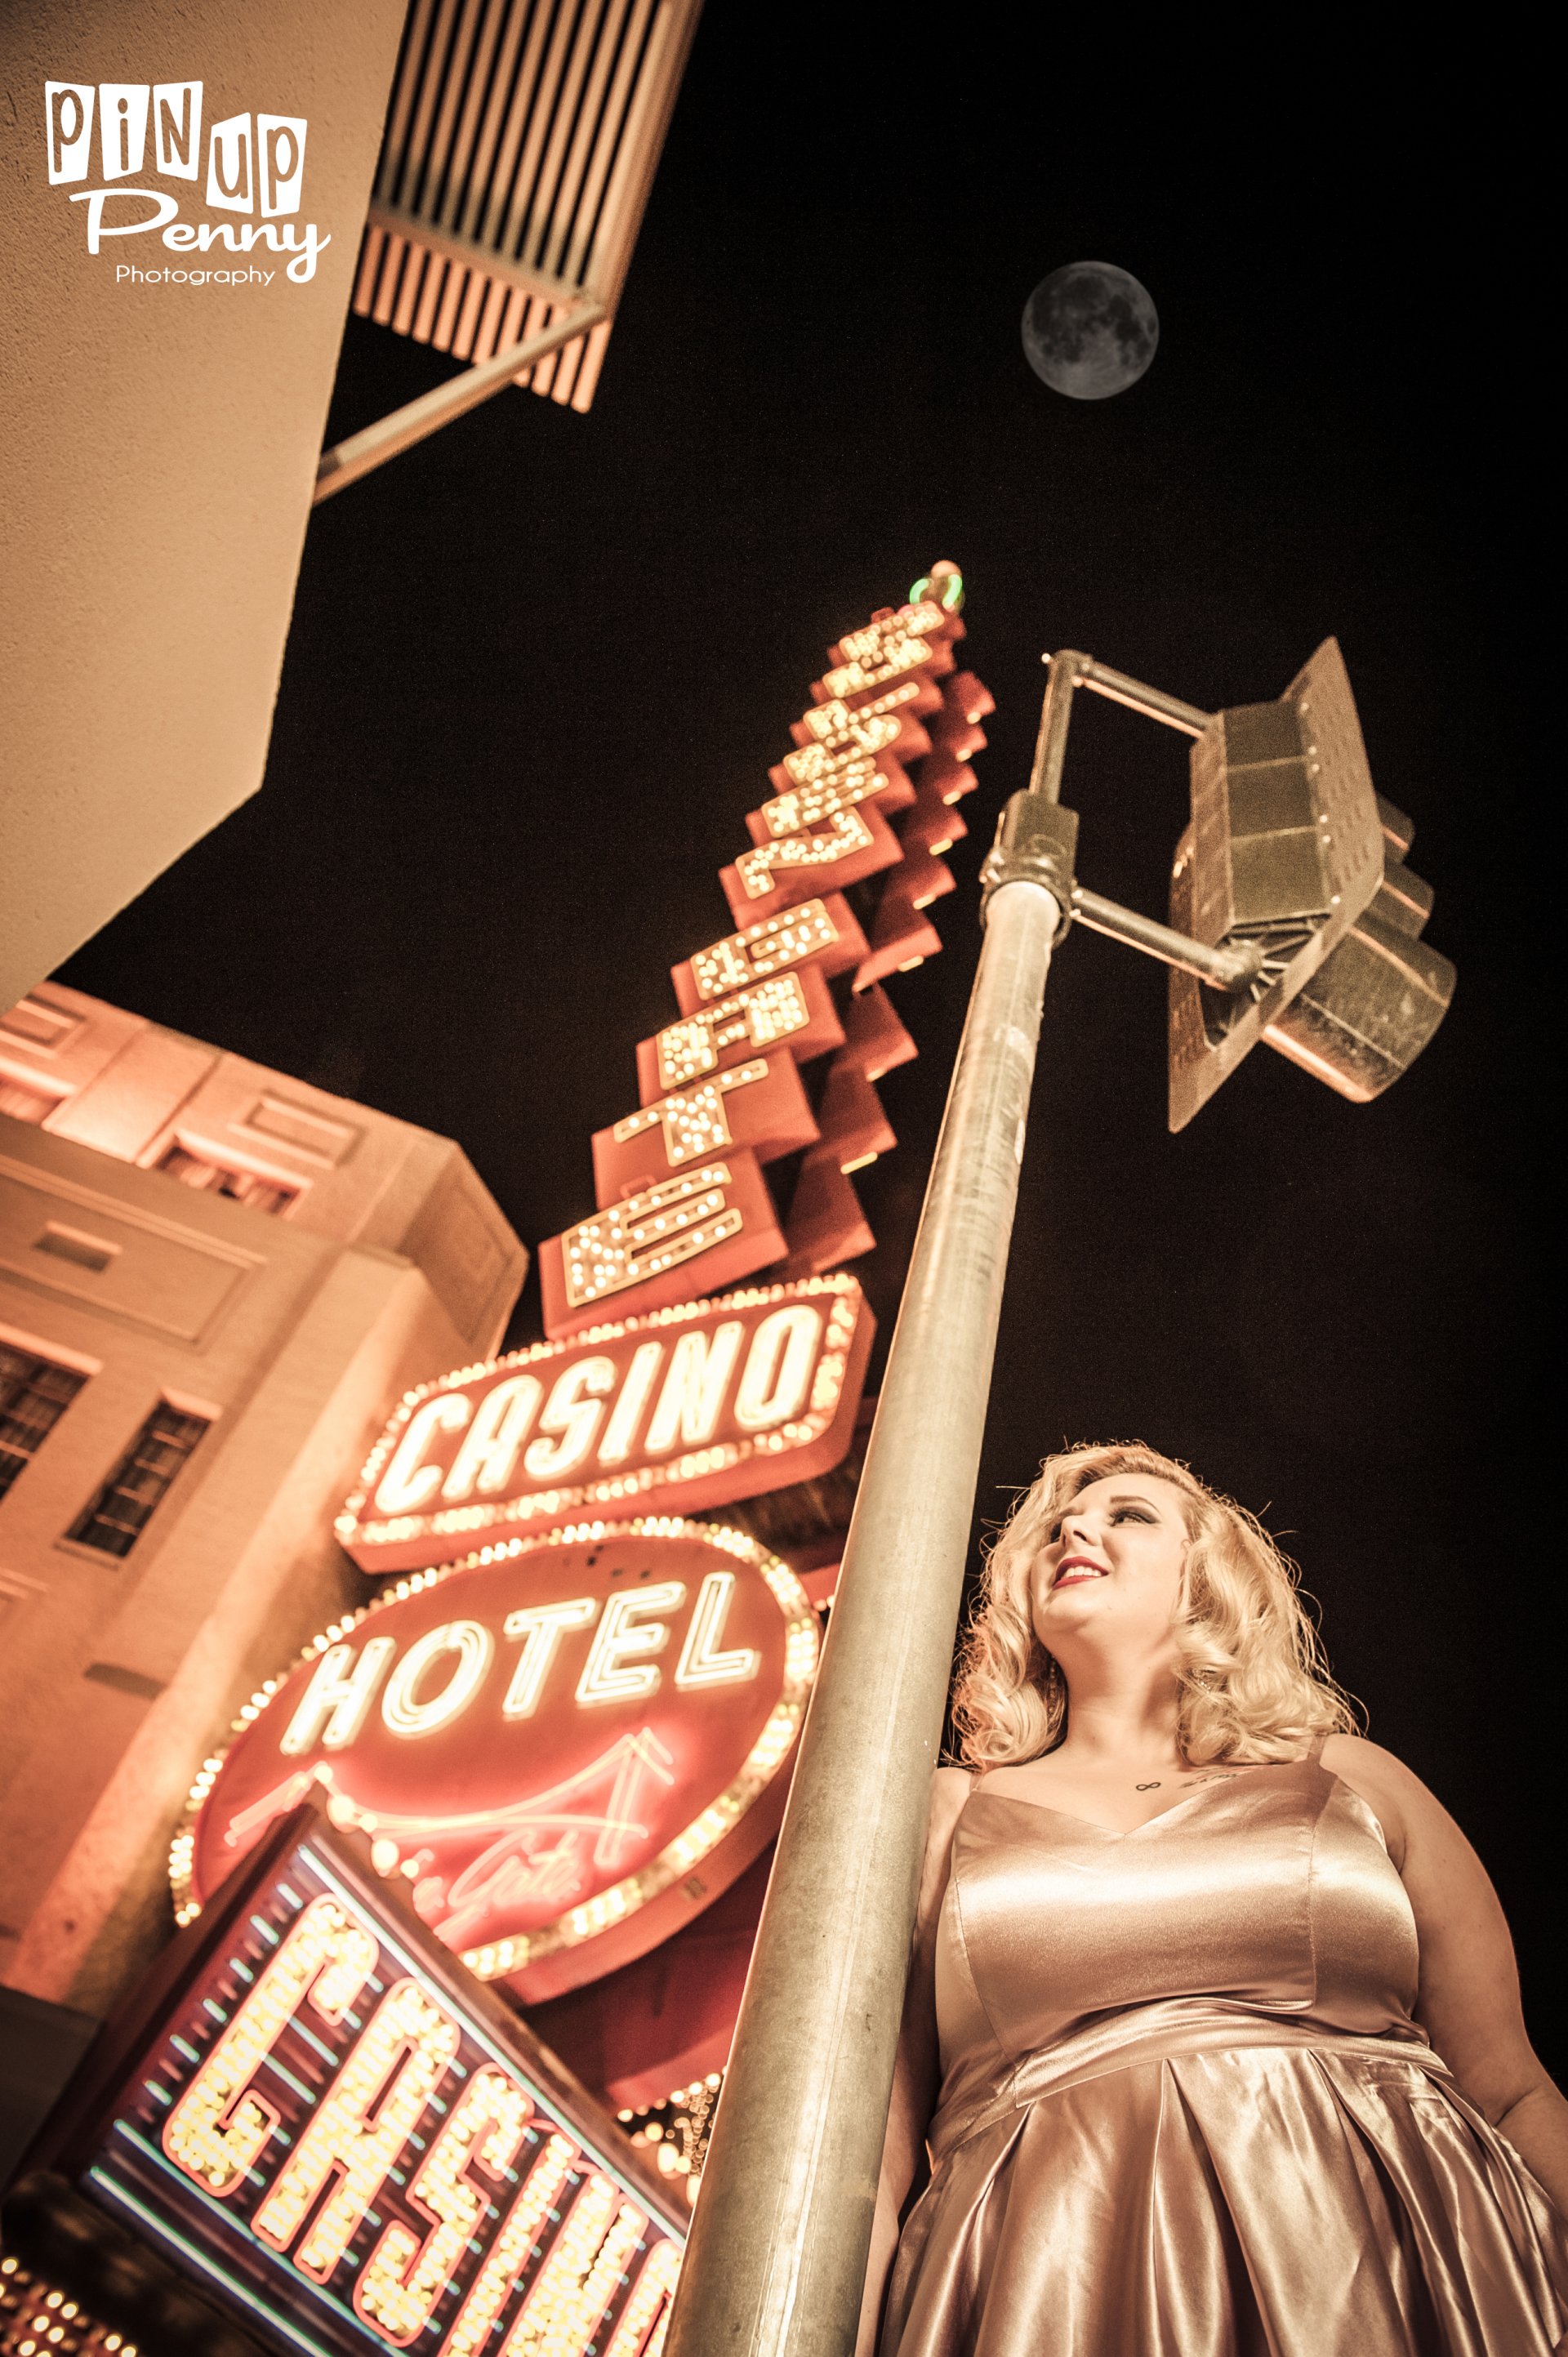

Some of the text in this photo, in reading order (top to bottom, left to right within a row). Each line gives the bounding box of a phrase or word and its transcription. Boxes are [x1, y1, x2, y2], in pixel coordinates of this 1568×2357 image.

[564, 898, 840, 1308] GATE
[373, 1304, 825, 1515] CASINO
[279, 1571, 760, 1757] HOTEL
